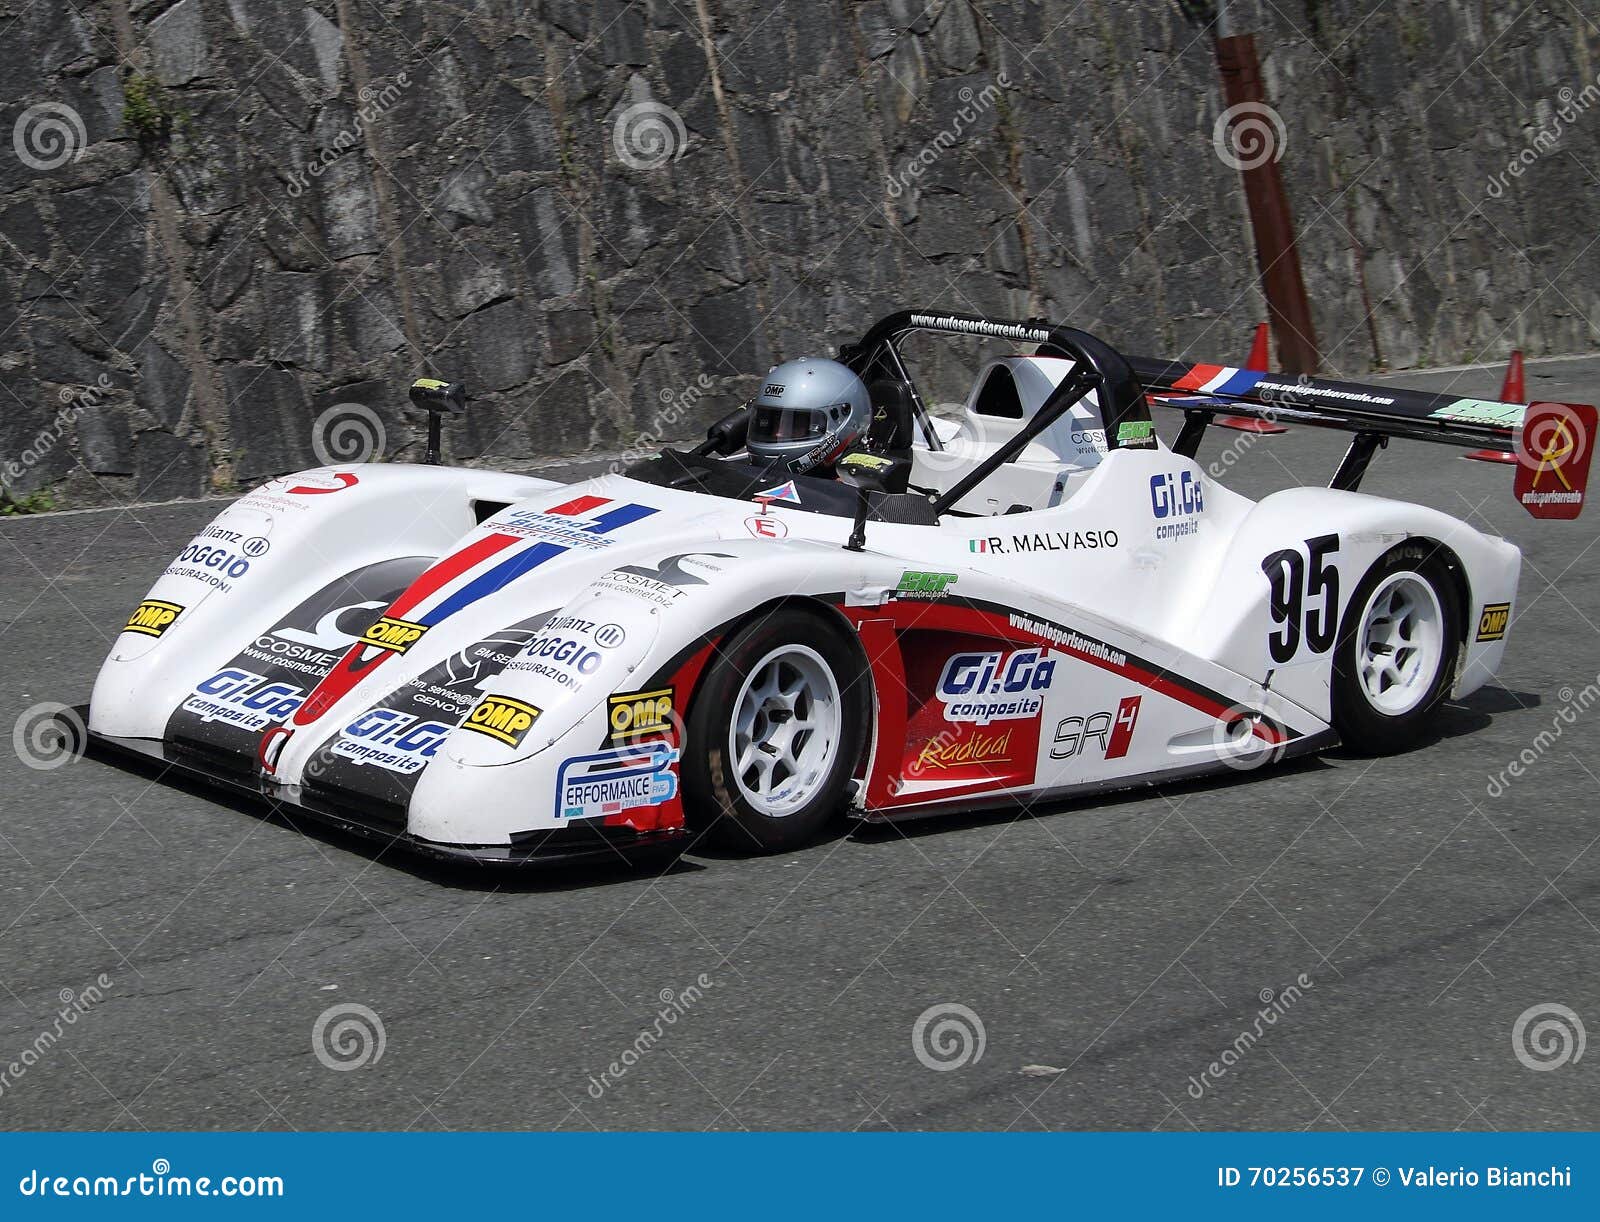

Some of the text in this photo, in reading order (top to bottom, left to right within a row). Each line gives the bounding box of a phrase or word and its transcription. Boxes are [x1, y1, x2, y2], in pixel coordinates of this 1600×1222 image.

[764, 386, 785, 396] OMP
[507, 519, 616, 544] Business
[510, 510, 592, 528] United
[1156, 516, 1199, 542] composite
[199, 525, 243, 544] llianz
[988, 530, 1119, 555] R. MALVASIO
[180, 543, 250, 579] OGGIO
[601, 572, 689, 599] COSMET
[1261, 533, 1340, 664] 95
[128, 606, 176, 629] OMP
[545, 616, 596, 634] Allianz
[1480, 611, 1507, 633] OMP
[366, 623, 422, 647] OMP
[243, 646, 331, 678] www.cosmet.bi
[474, 647, 496, 659] BM
[188, 698, 264, 727] composite
[471, 703, 532, 735] OMP
[610, 695, 673, 731] OMP
[949, 698, 1039, 720] composite
[337, 740, 421, 770] composite
[914, 727, 1013, 771] Radical
